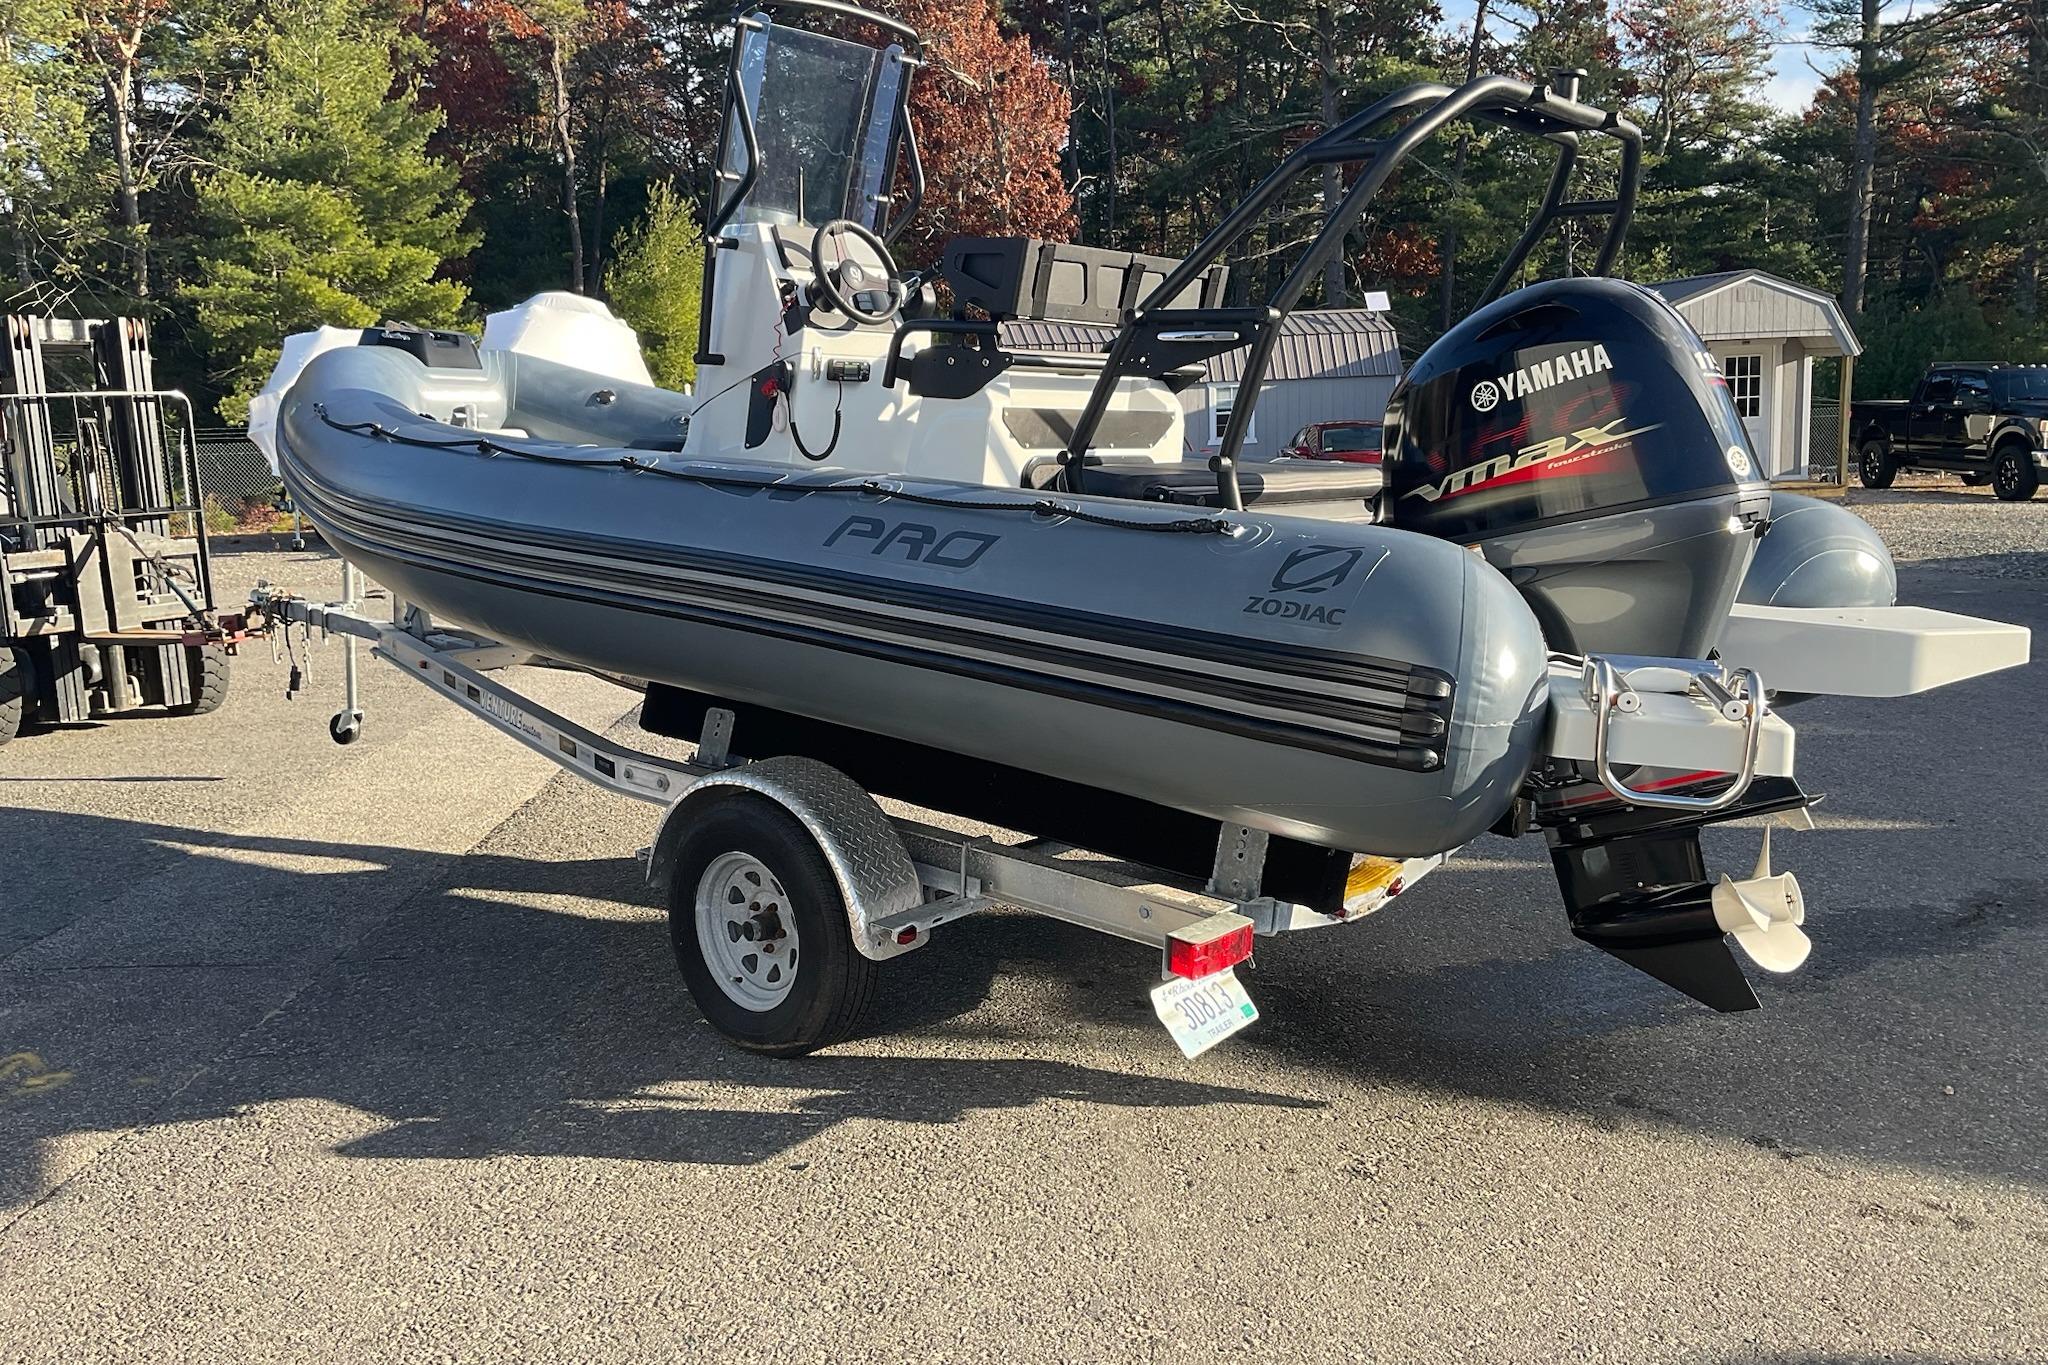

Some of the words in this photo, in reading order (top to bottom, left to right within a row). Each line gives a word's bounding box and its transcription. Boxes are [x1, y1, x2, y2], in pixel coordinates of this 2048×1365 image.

[1498, 344, 1613, 401] YAMAHA
[1547, 441, 1632, 470] fourstroke
[822, 515, 1001, 569] PRO
[1243, 596, 1346, 625] ZODIAC
[480, 689, 523, 730] VENTURE
[1175, 982, 1234, 1030] 3D813
[1208, 1018, 1234, 1039] TRAILER
